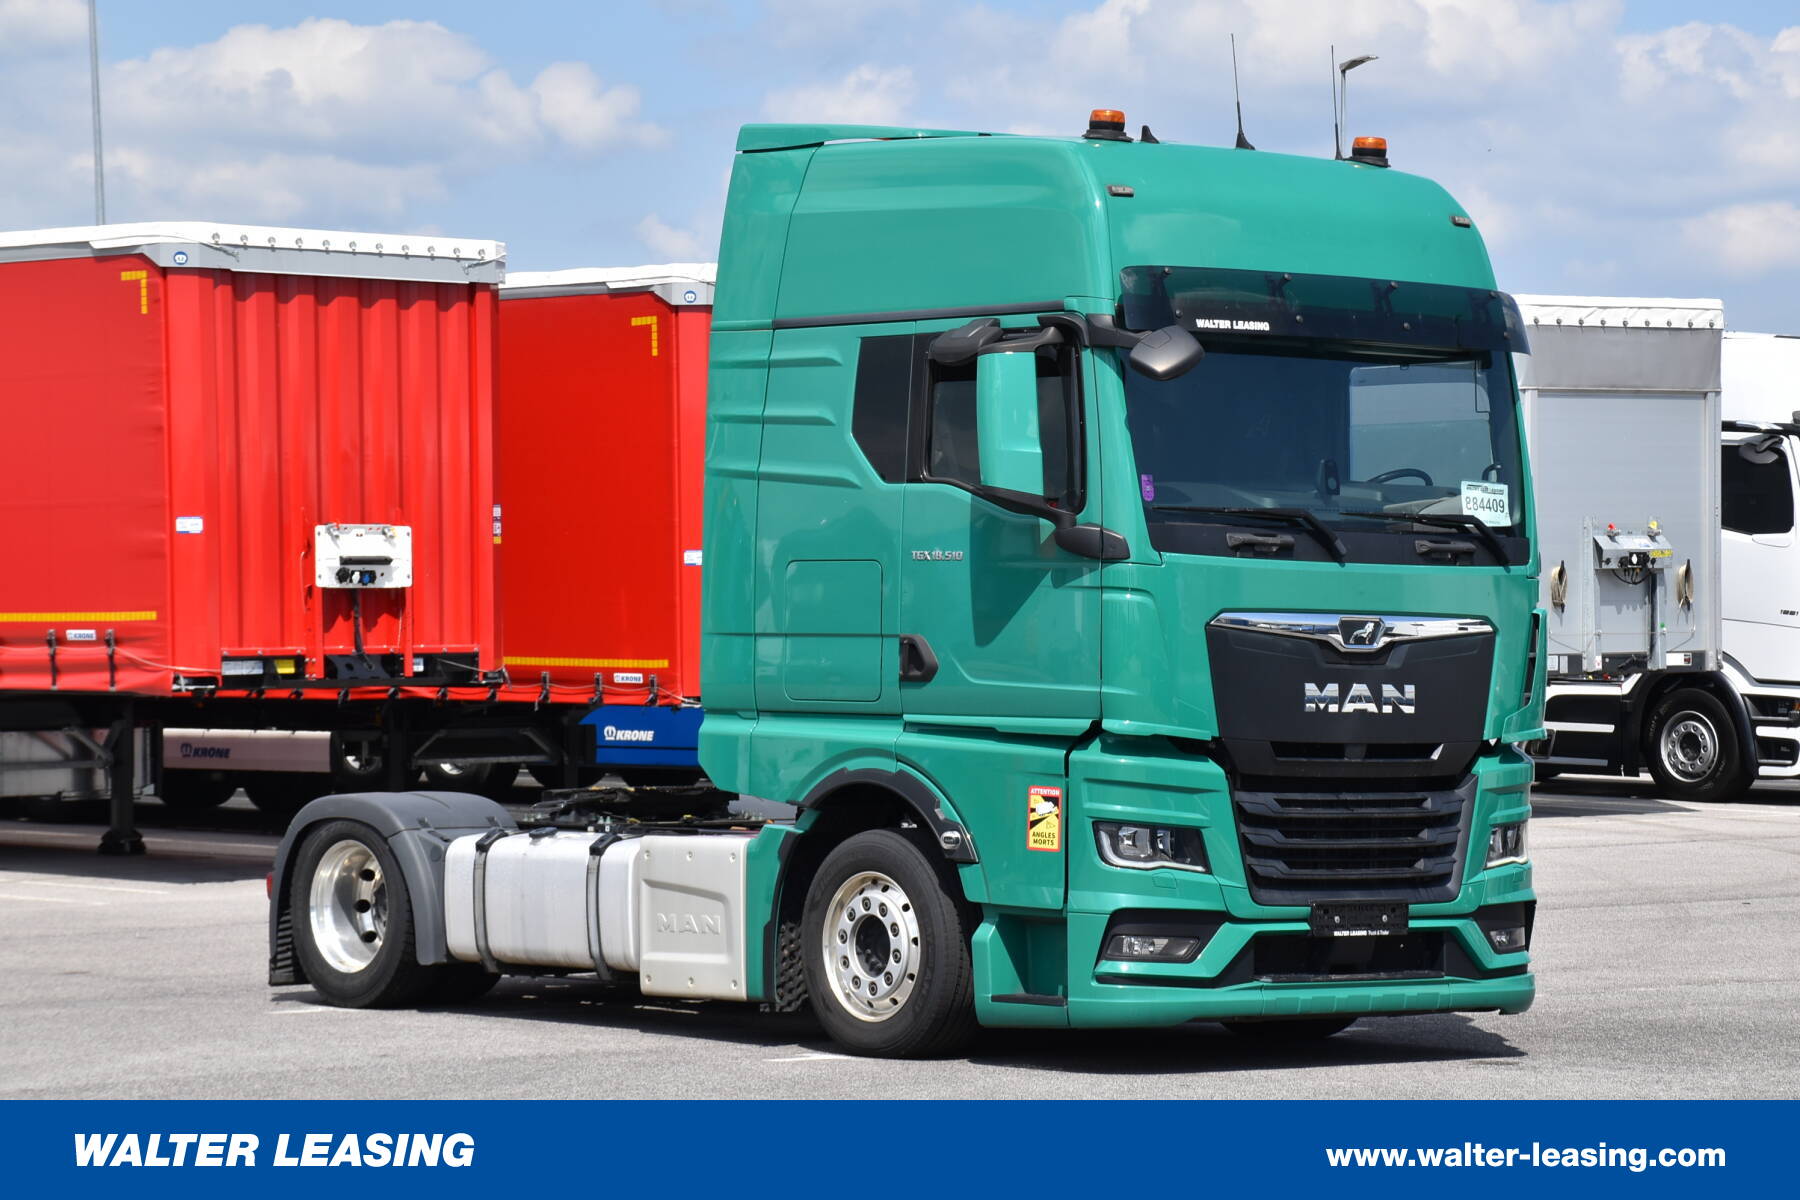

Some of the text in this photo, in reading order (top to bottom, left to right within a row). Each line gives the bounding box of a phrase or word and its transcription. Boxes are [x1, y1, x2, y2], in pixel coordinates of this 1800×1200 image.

[1195, 318, 1270, 331] WALTER LEASING
[1304, 682, 1416, 714] MAN
[615, 729, 655, 741] KRONE
[192, 746, 231, 759] KRONE
[1030, 787, 1060, 796] ATTENTION
[1032, 831, 1056, 839] ANGLES
[1033, 838, 1055, 846] MORTS
[656, 912, 721, 936] MAN
